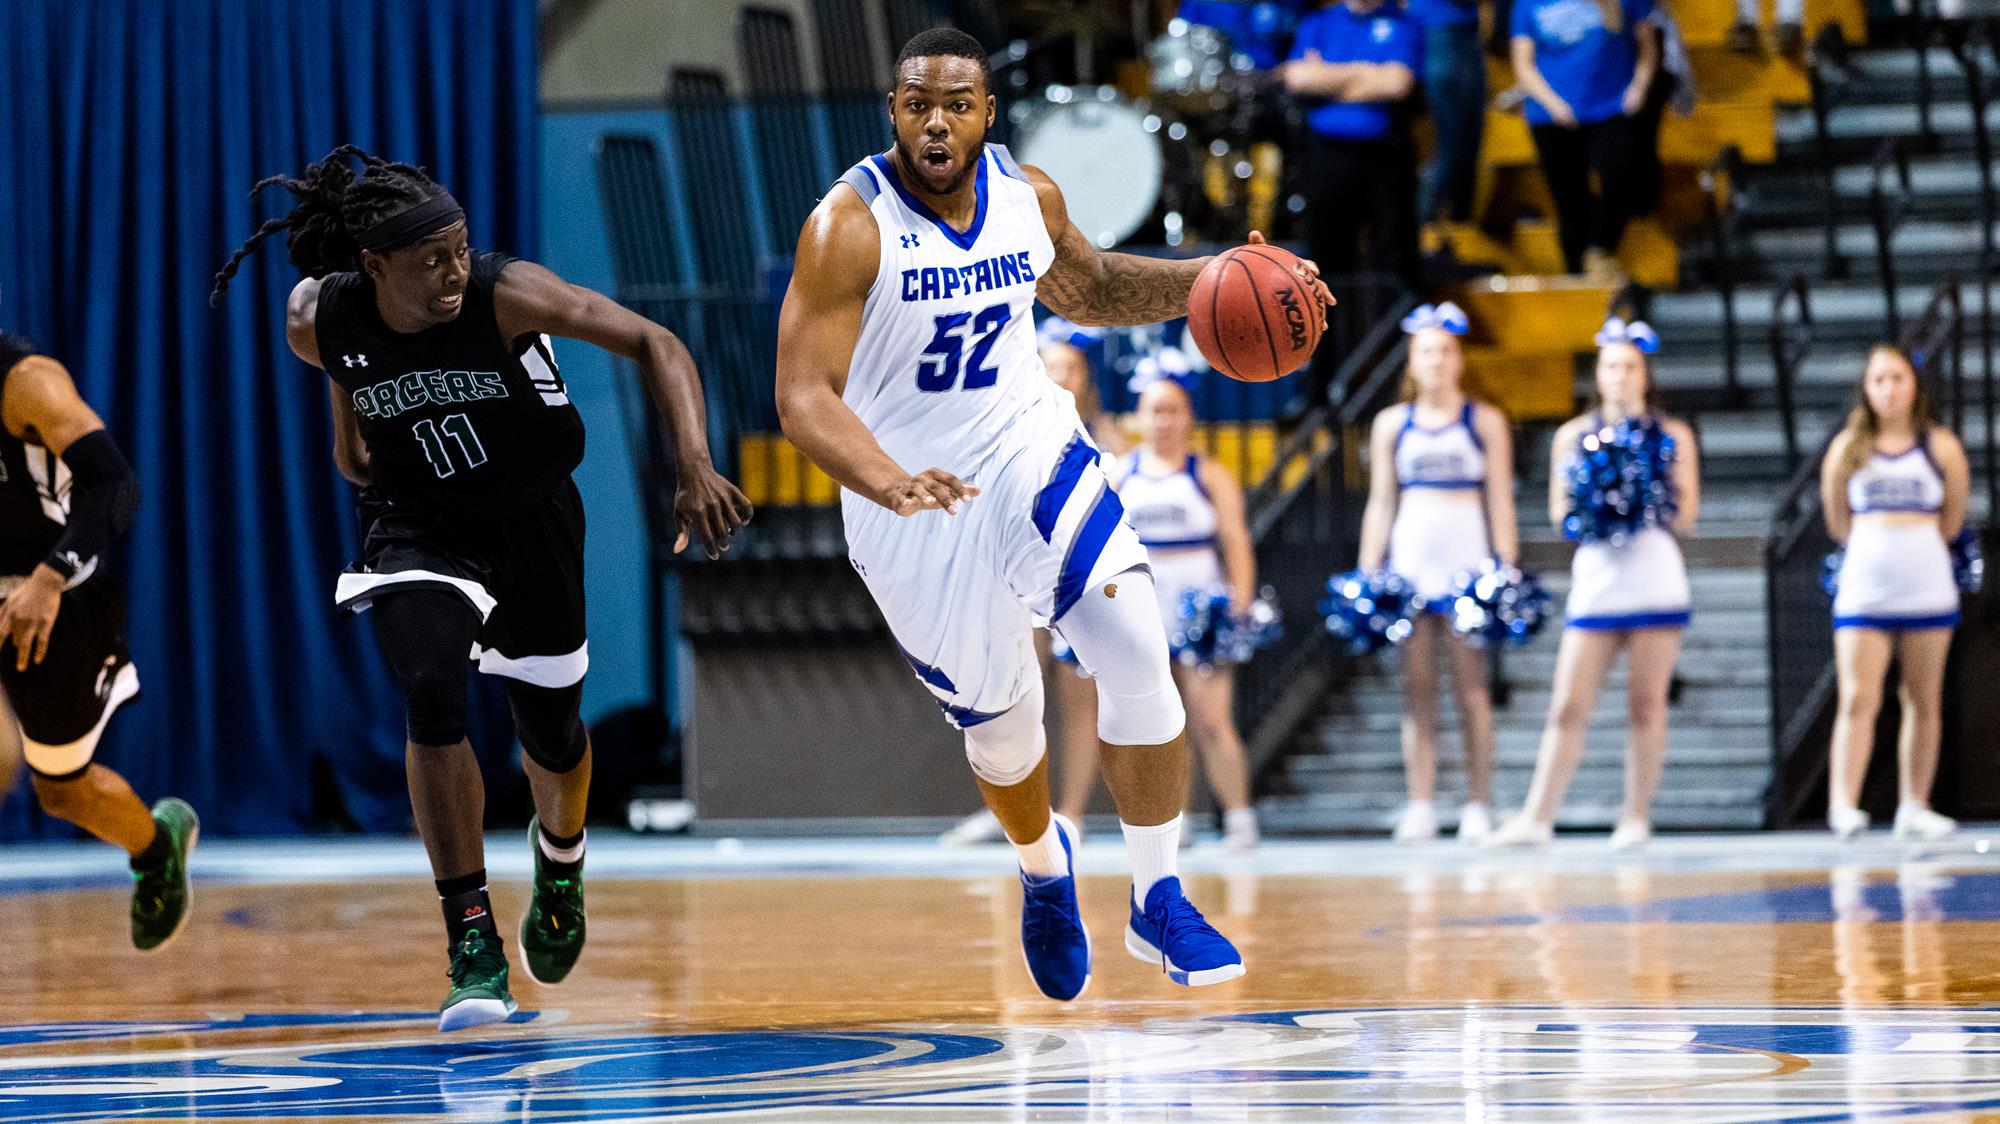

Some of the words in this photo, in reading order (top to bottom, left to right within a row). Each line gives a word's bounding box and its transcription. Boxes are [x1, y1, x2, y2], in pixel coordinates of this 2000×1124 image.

[901, 251, 1035, 302] CAPTAINS
[915, 302, 1012, 393] 52
[1275, 287, 1307, 352] NCAA
[352, 369, 509, 419] PACERS
[411, 413, 488, 479] 11
